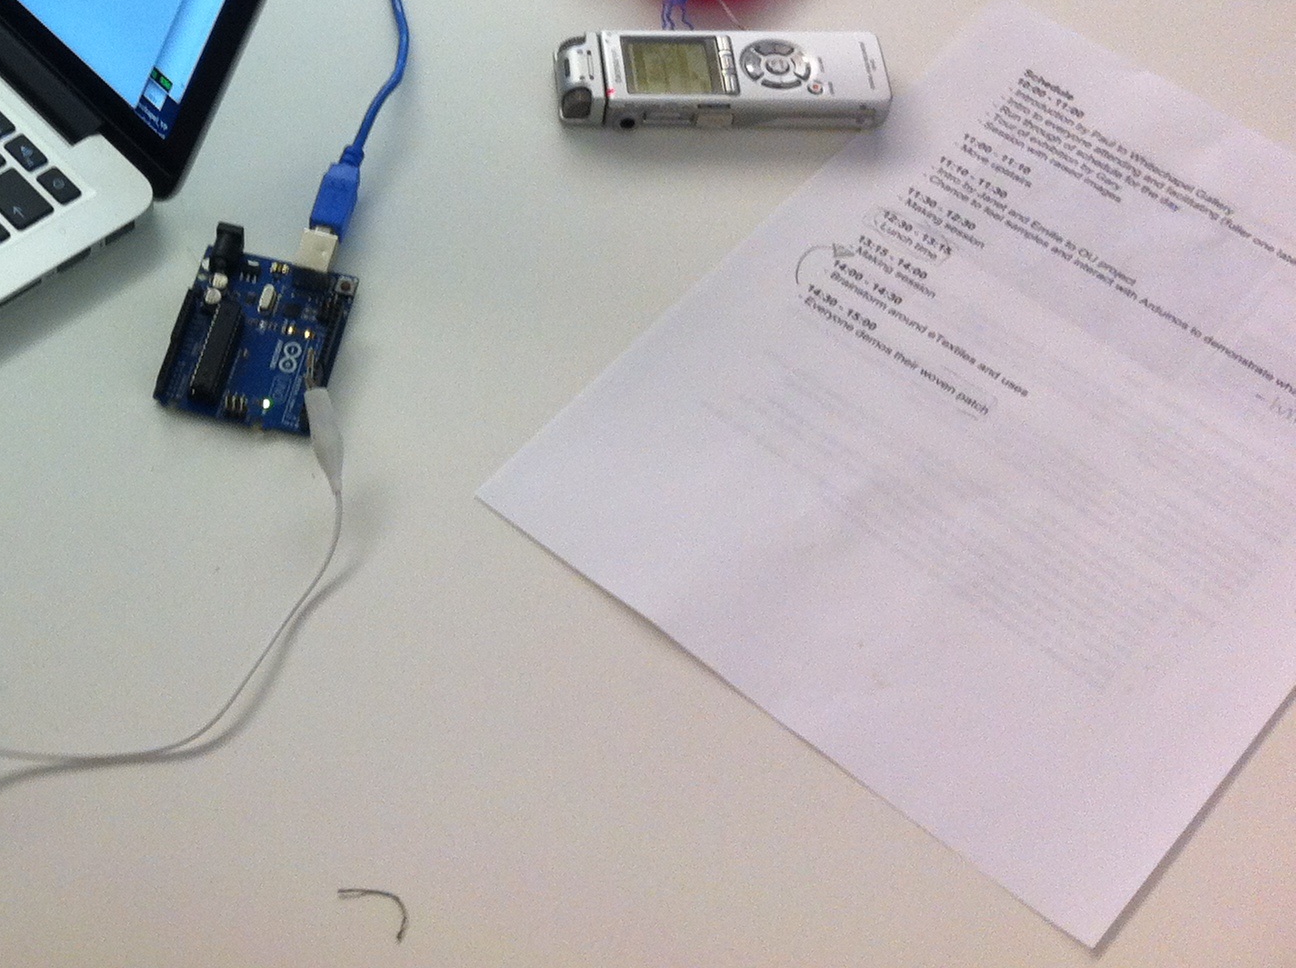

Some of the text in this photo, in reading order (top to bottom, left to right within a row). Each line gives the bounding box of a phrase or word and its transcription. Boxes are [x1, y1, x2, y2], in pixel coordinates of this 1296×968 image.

[1015, 77, 1048, 97] 10:00
[1053, 98, 1085, 119] 11:00
[1022, 68, 1076, 101] Schedule
[990, 113, 1017, 131] Tour
[1005, 97, 1032, 114] Intro
[1091, 145, 1143, 177] attending
[959, 144, 991, 164] Move
[998, 105, 1023, 122] Run
[1074, 148, 1125, 179] schedule
[1013, 89, 1076, 126] Introduction
[1089, 130, 1117, 148] Paul
[1126, 151, 1197, 193] Whitechapel
[935, 167, 963, 185] Intro
[902, 198, 945, 226] Making
[878, 222, 915, 246] Lunch
[853, 246, 896, 274] Making
[927, 174, 971, 203] Chance
[1200, 333, 1278, 382] demonstrate
[828, 270, 890, 310] Brainstorm
[886, 306, 928, 334] around
[802, 296, 856, 332] Everyone
[954, 390, 991, 416] patch
